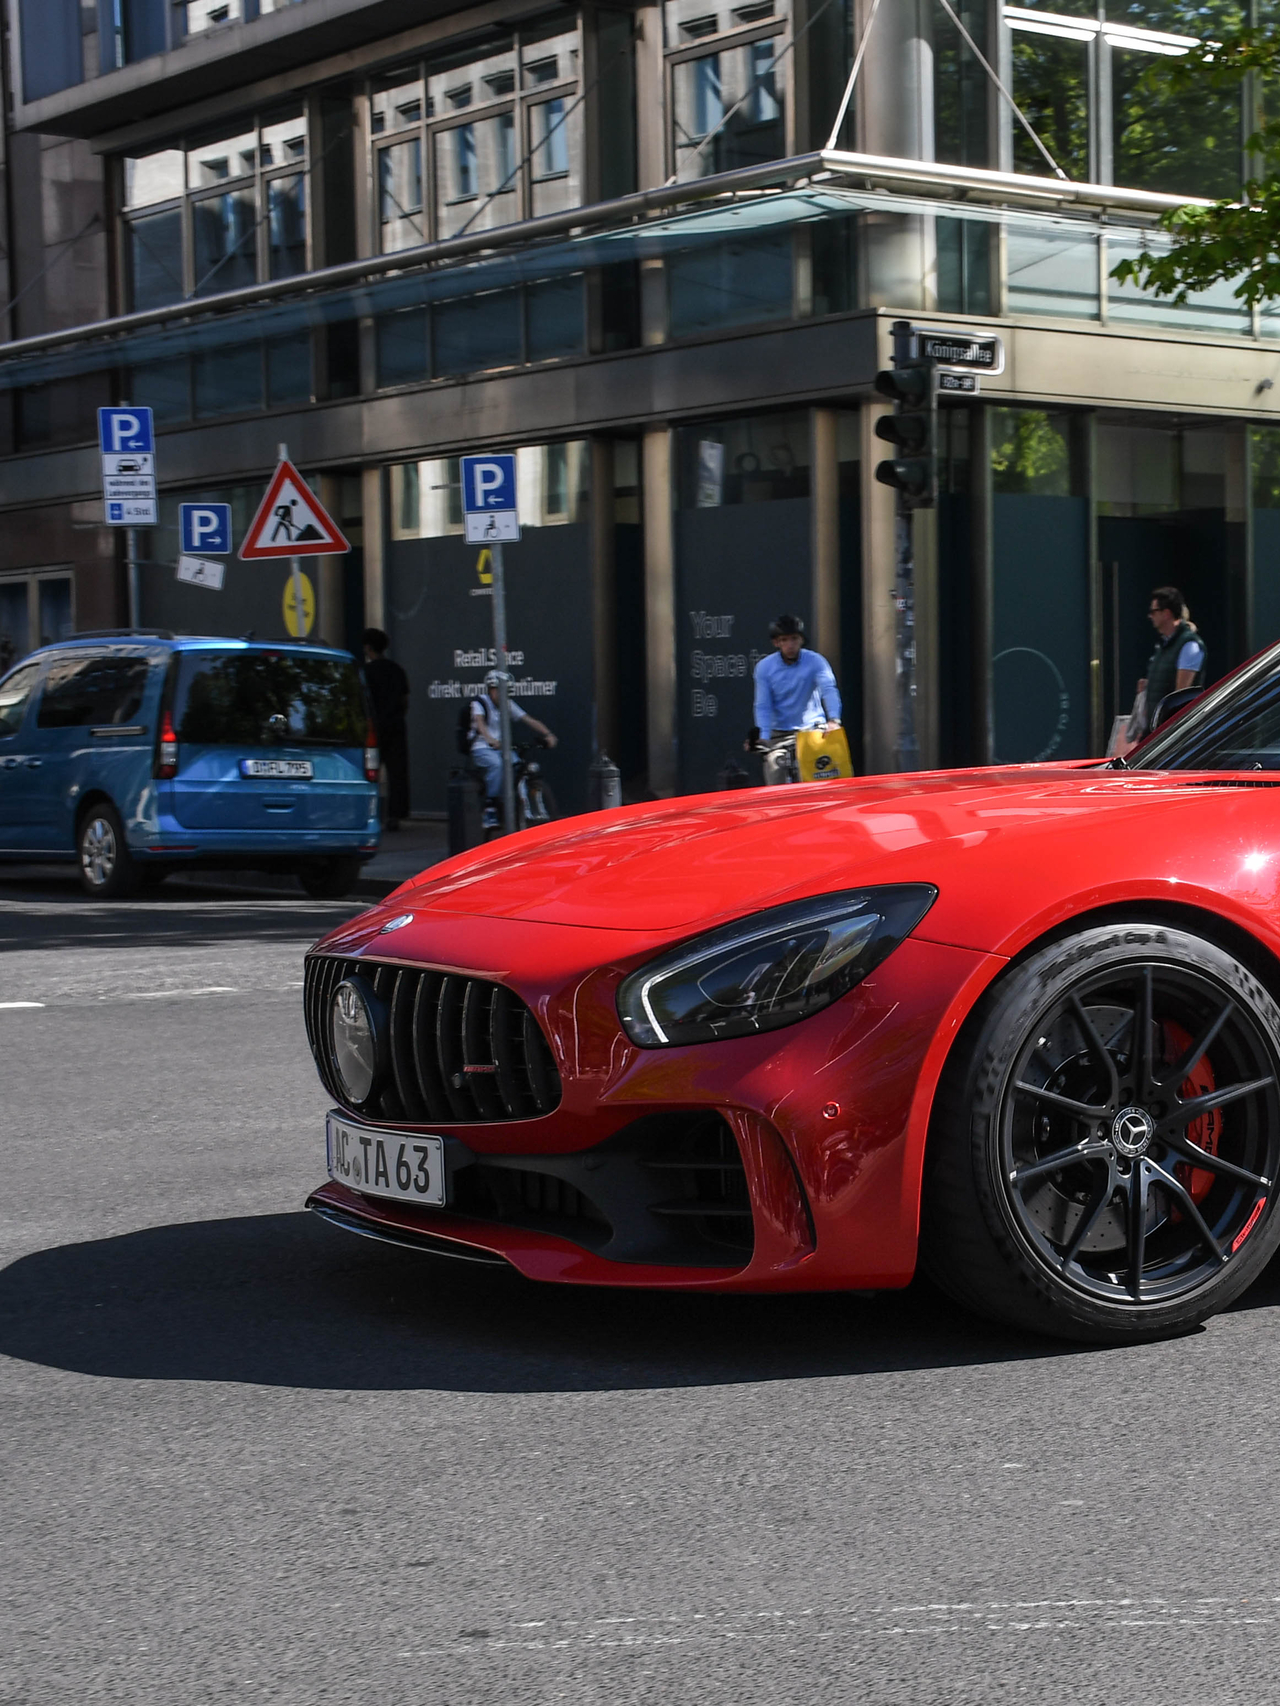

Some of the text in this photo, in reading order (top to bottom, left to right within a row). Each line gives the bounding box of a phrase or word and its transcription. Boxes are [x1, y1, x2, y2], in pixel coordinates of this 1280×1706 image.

[110, 414, 141, 451] P
[473, 463, 505, 507] P
[191, 510, 219, 547] P
[689, 611, 735, 639] Your
[690, 650, 748, 683] Space
[692, 689, 719, 717] Be
[359, 1136, 390, 1188] TA
[396, 1142, 430, 1194] 63
